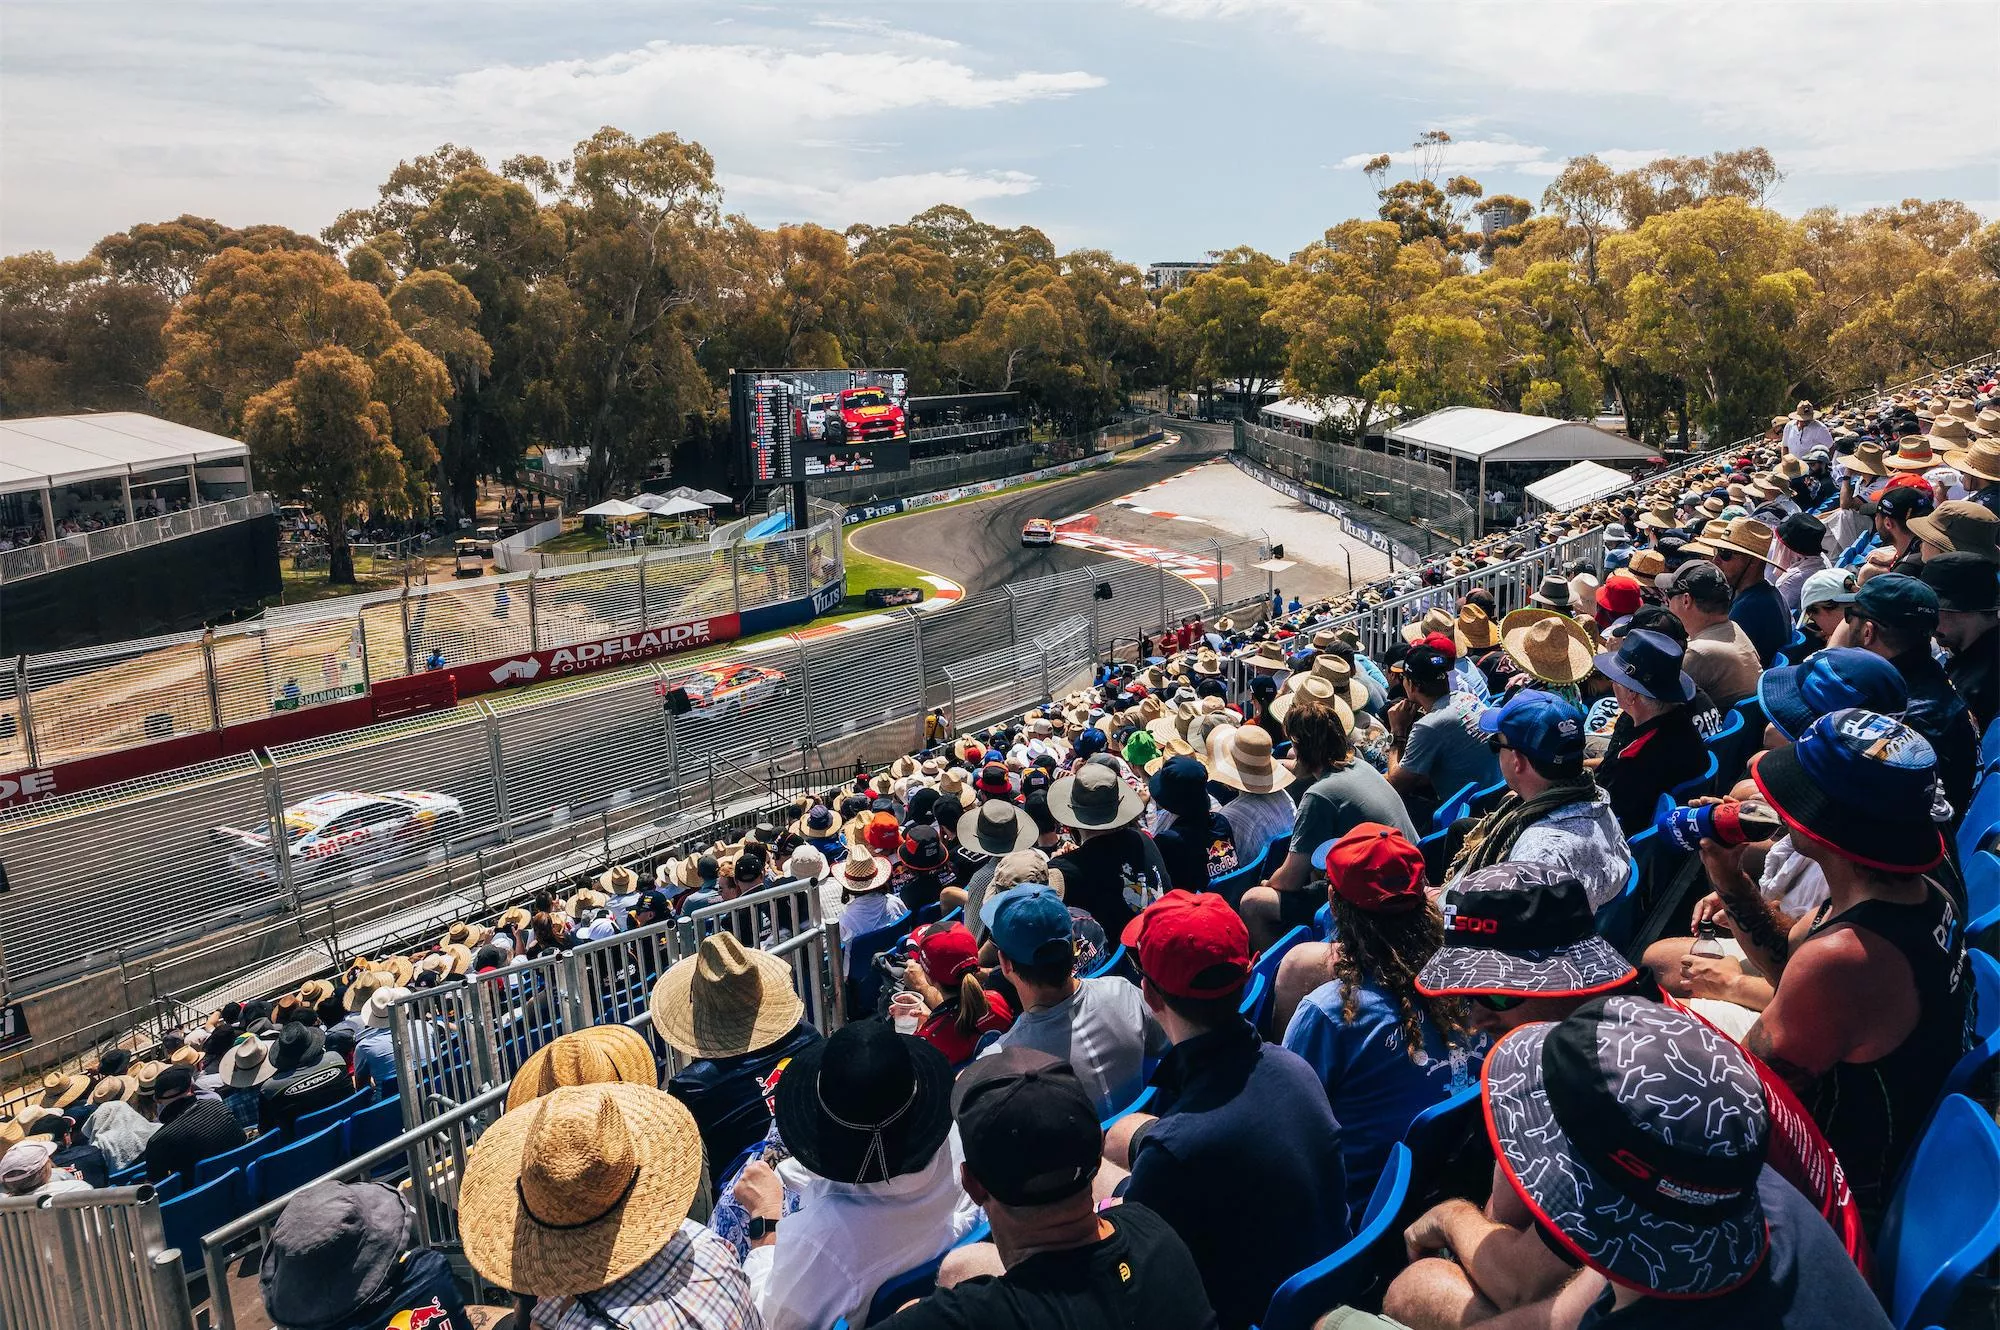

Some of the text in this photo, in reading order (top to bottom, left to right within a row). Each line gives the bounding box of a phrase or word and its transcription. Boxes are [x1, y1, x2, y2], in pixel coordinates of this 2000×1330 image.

[864, 504, 897, 520] PIES
[550, 620, 710, 667] ADELAIDE
[550, 634, 711, 675] SOUTH AUSTRALIA
[297, 685, 356, 706] SHANNONS
[1207, 857, 1226, 878] Red
